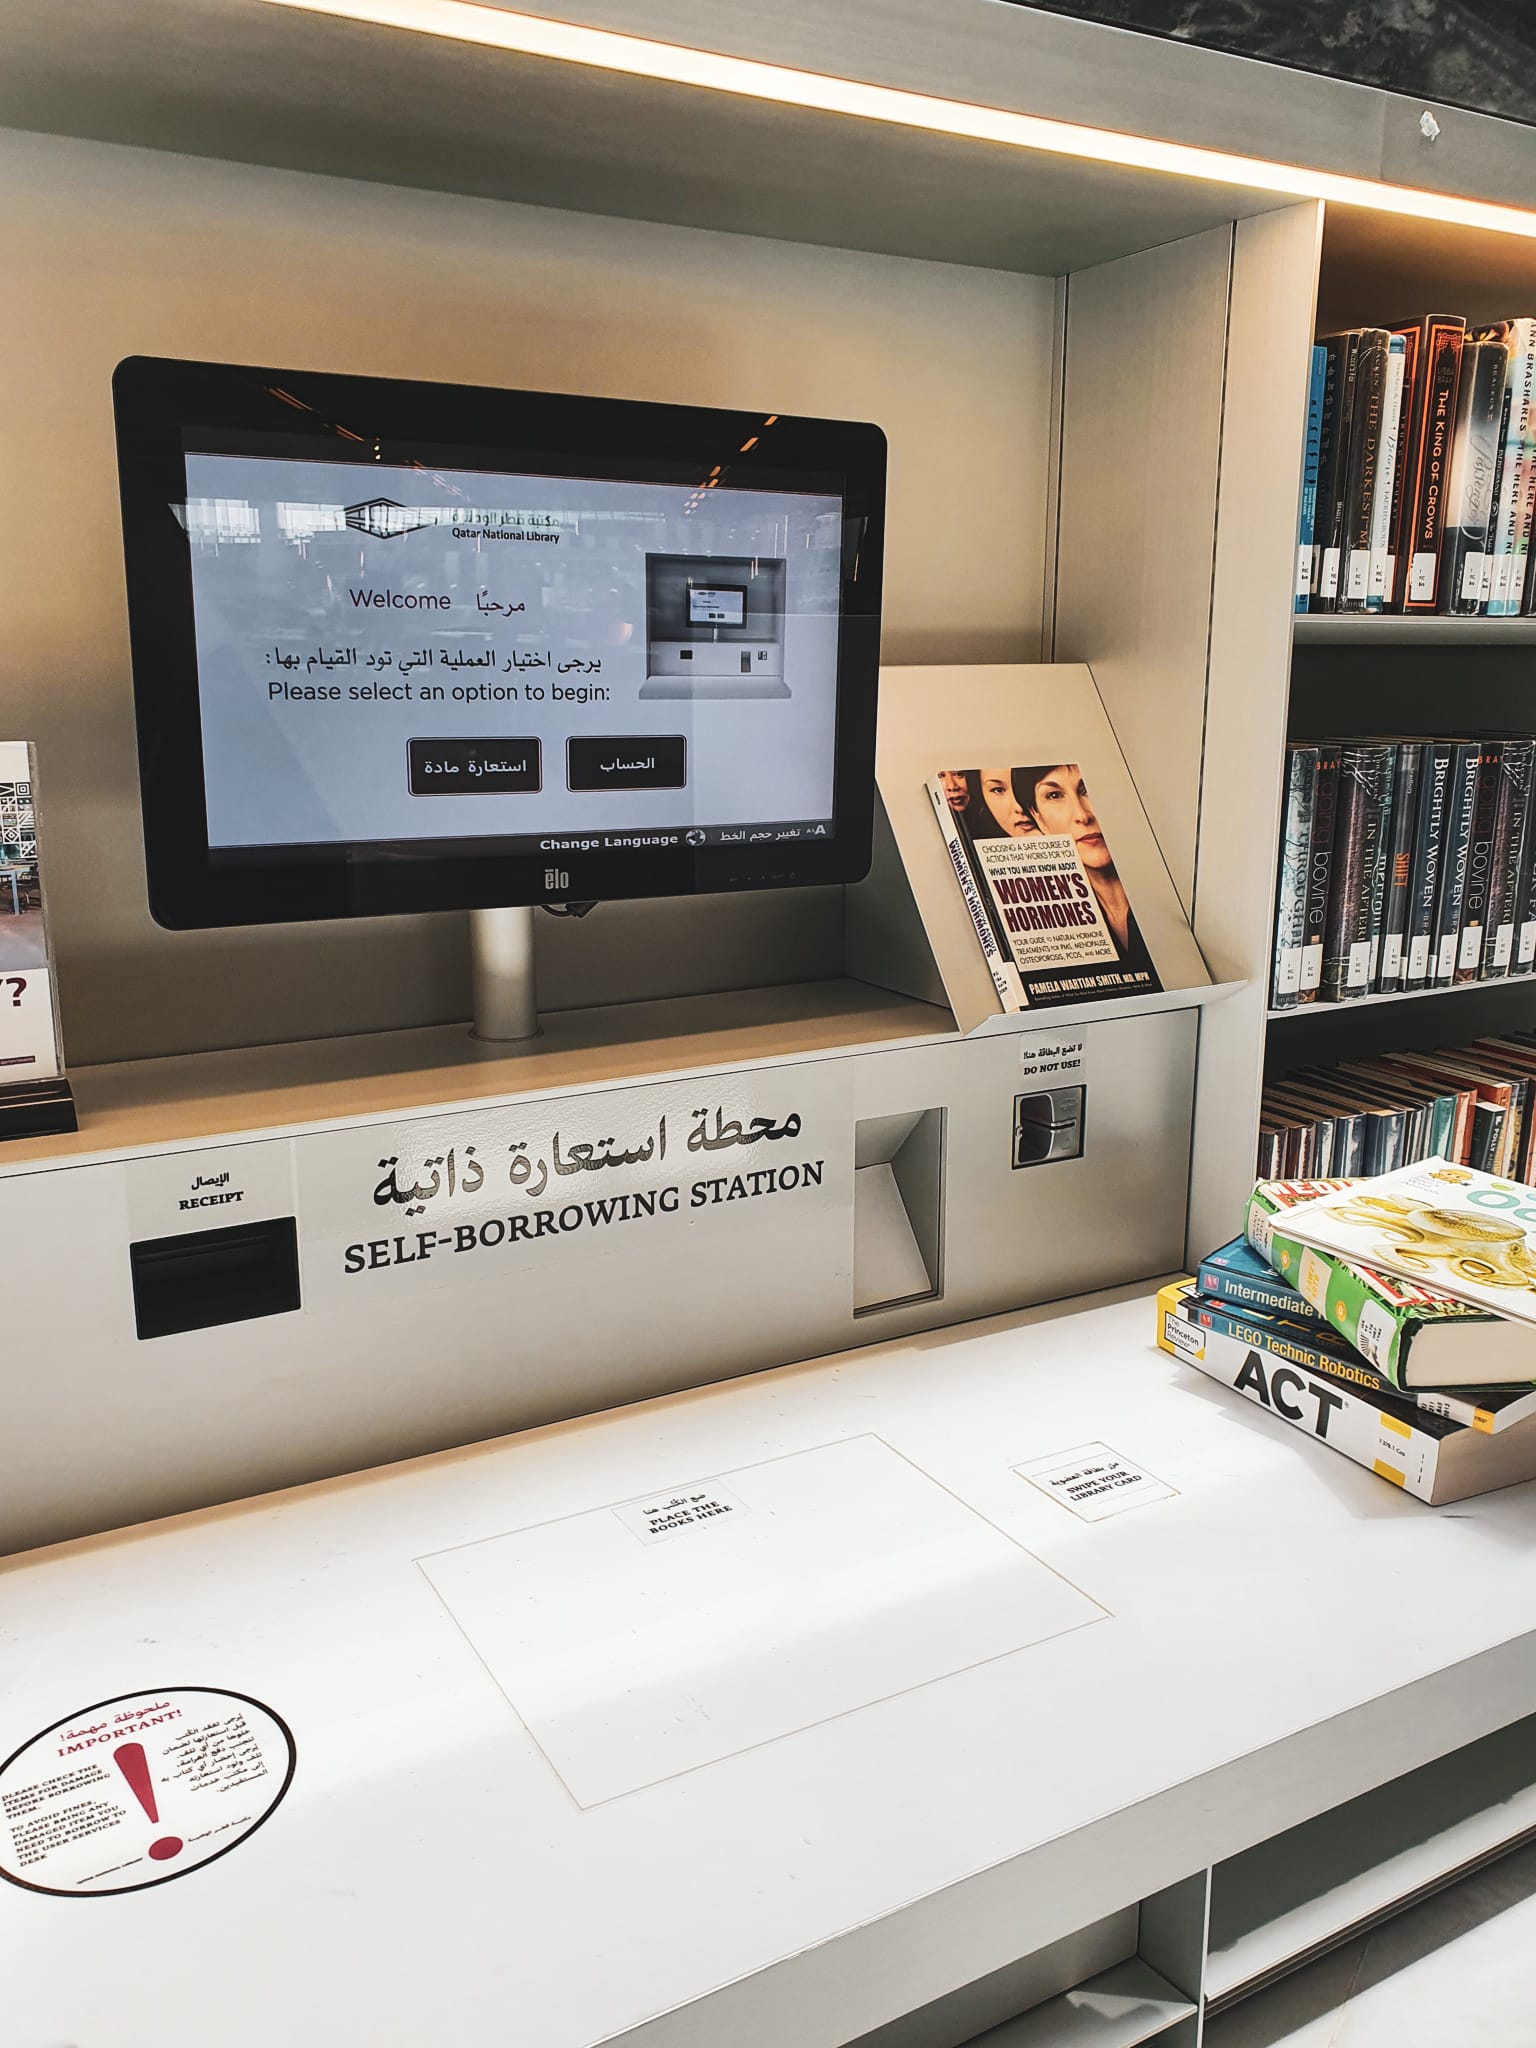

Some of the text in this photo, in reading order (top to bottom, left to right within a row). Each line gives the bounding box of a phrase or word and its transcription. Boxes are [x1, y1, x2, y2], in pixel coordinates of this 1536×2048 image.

[1519, 353, 1535, 432] BRASHARES
[1361, 394, 1381, 520] THE DARKEST
[1424, 390, 1449, 540] THE KING OF CROWS
[1507, 445, 1524, 536] THE HERE AND
[1526, 477, 1536, 507] HERE
[452, 527, 560, 544] Qatar National Library
[1522, 514, 1532, 538] AND
[349, 589, 451, 609] Welcome
[306, 648, 357, 673] القيام
[366, 651, 393, 671] تود
[398, 650, 433, 676] التي
[440, 650, 496, 671] العملية
[502, 650, 551, 673] اختيار
[557, 657, 602, 673] يرجى
[268, 682, 610, 704] Please select an option to begin:
[424, 760, 527, 777] استعارة مادة
[600, 757, 655, 772] الحساب
[540, 834, 679, 851] Change Language
[719, 828, 801, 843] تغيير حجم الخط
[1422, 758, 1449, 908] BRIGHTLY WOVEN
[1452, 758, 1479, 906] BRIGHTLY WOVEN
[1509, 812, 1523, 865] IN THE
[982, 839, 1071, 854] CHOOSING A SAFE COURSE OF
[986, 849, 1075, 863] ACTION THAT WORKS FOR YOU
[1363, 823, 1377, 879] IN THE
[989, 862, 1078, 876] WHAT YOU MUST KNOW ABOUT
[1393, 852, 1410, 888] SHIFT
[1468, 841, 1493, 909] bovine
[948, 839, 995, 959] WOMEN'S HORMONES
[993, 873, 1089, 905] WOMEN'S
[1309, 851, 1333, 924] bovine
[1003, 901, 1097, 933] HORMONES
[1013, 930, 1104, 946] YOUR GUIDE NATURAL HORMONE
[1016, 944, 1050, 955] TREATMENTS
[1095, 947, 1112, 956] MORE
[1028, 979, 1061, 995] PAMELA
[1061, 976, 1097, 991] WARTIAN
[1024, 1059, 1081, 1075] DO NOT USE!
[373, 1106, 802, 1217] محطة استعارة ذاتية
[191, 1172, 229, 1190] الإيصال
[179, 1191, 244, 1210] RECEIPT
[344, 1160, 825, 1274] SELF-BORROWING STATION
[1225, 1279, 1314, 1317] Intermediate
[1168, 1315, 1180, 1328] The
[1167, 1323, 1200, 1347] Princeton
[1167, 1332, 1191, 1349] Review
[1228, 1322, 1381, 1390] LEGO Technic Robotics
[1233, 1350, 1343, 1439] ACT
[1066, 1471, 1130, 1494] SWIPE YOUR
[1070, 1475, 1142, 1501] LIBRARY CARD
[649, 1501, 720, 1526] PLACE THE
[649, 1505, 733, 1534] BOOKS HERE
[114, 1701, 171, 1724] ملحوظة
[57, 1709, 183, 1757] IMPORTANT!
[1, 1764, 98, 1802] PLEASE CHECK THE
[3, 1769, 103, 1807] ITEMS FOR DAMAGE
[5, 1773, 111, 1813] BEFORE BORROWING
[10, 1824, 24, 1833] TO
[27, 1812, 60, 1828] AVOID
[12, 1801, 109, 1840] PLEASE BRING ANY
[14, 1805, 119, 1847] DAMAGED ITEM YOU
[16, 1809, 127, 1854] NEED TO BORROW TO
[17, 1819, 121, 1860] THE USER SERVICES
[20, 1853, 48, 1868] DESK
